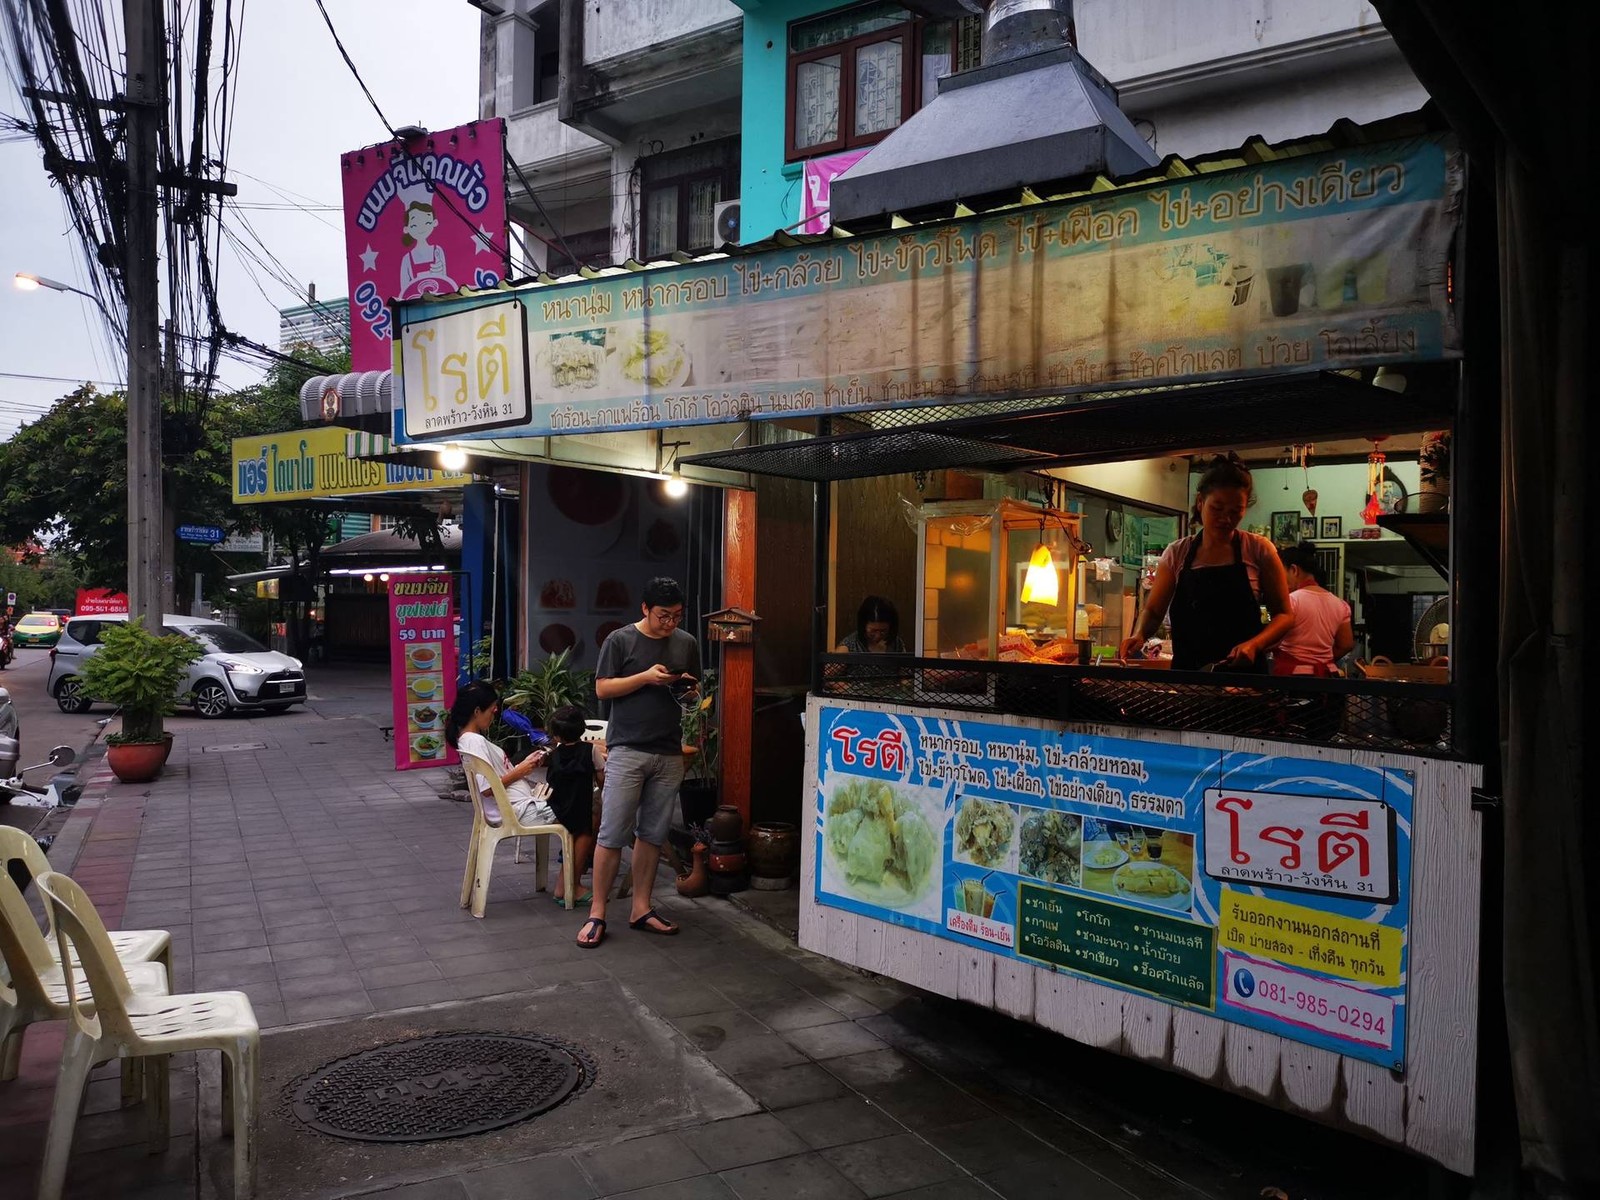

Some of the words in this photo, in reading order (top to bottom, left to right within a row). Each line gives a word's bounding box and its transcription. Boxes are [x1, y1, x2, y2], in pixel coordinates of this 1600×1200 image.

[543, 291, 612, 324] หนานุ่ม
[623, 267, 727, 315] หนากรอบ
[734, 254, 840, 293] ไข่+กล้วย
[848, 226, 996, 280] ไข่+ข้าวโพด
[1007, 198, 1139, 253] ไข่+เผือก
[1150, 160, 1405, 230] ไข่+อย่างเดียว
[412, 314, 509, 411] โรตี
[425, 405, 498, 429] ลาดพร้าว-วังหิน
[503, 404, 513, 416] 31
[551, 402, 660, 428] ชาร้อน-กาแฟร้อน
[664, 396, 699, 419] โกโก้
[770, 388, 815, 411] นมสด
[823, 378, 873, 407] ชาเย็น
[237, 446, 268, 496] แอร์
[209, 529, 220, 538] 31
[394, 577, 449, 597] ขนมจีน
[399, 629, 417, 641] 59
[421, 628, 446, 640] บาท
[832, 728, 904, 773] โรตี
[920, 735, 982, 758] หนากรอบ,
[988, 742, 1040, 766] หนานุ่ม,
[1045, 746, 1149, 781] ไข่+กล้วยหอม,
[1131, 793, 1183, 817] ธรรมดา
[1216, 797, 1370, 878] โรตี
[1221, 866, 1347, 890] ลาดพร้าว-วังหิน
[1357, 881, 1375, 893] 31
[1032, 897, 1063, 915] ชาเย็น
[1032, 915, 1060, 933] กาแฟ
[1231, 903, 1381, 951] รับออกงานนอกสถานที่
[1030, 933, 1071, 954] โอวัลติน
[1082, 929, 1130, 952] ชามะนาว
[1227, 926, 1246, 944] เปิด
[1250, 932, 1294, 956] บ่ายสอง
[1350, 957, 1386, 977] ทุกวัน
[1082, 950, 1120, 968] ชาเขียว
[1258, 980, 1386, 1035] 081-985-0294
